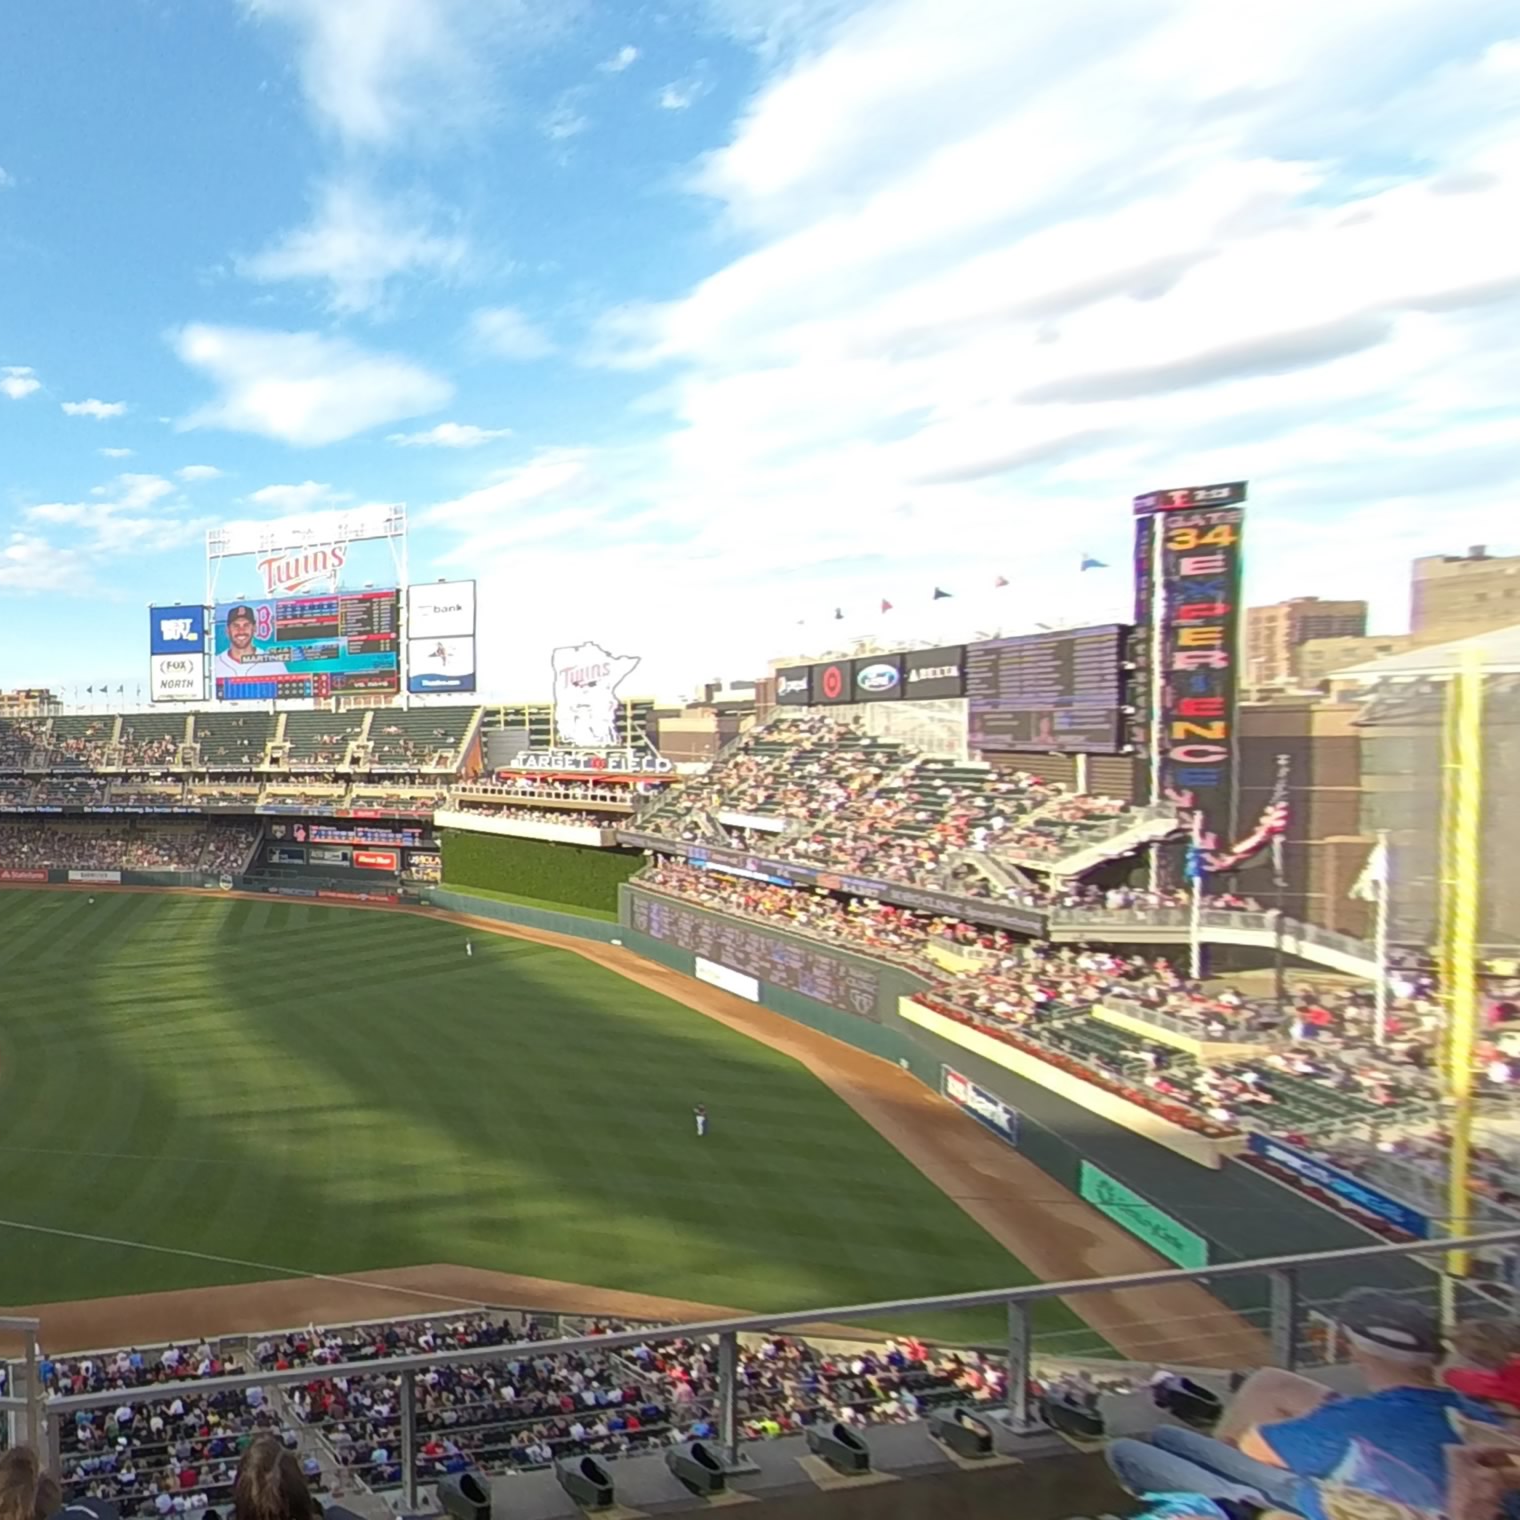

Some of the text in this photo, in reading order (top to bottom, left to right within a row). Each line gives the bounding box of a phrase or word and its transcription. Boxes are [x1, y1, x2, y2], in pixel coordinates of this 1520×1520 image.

[1167, 524, 1238, 551] 34
[257, 546, 344, 592] Twins
[433, 604, 462, 613] bank
[166, 661, 186, 669] FOX
[242, 654, 290, 662] MARTINEZ
[560, 662, 610, 689] Twins
[160, 679, 194, 689] NORTH
[516, 754, 672, 772] TARGET FIELD
